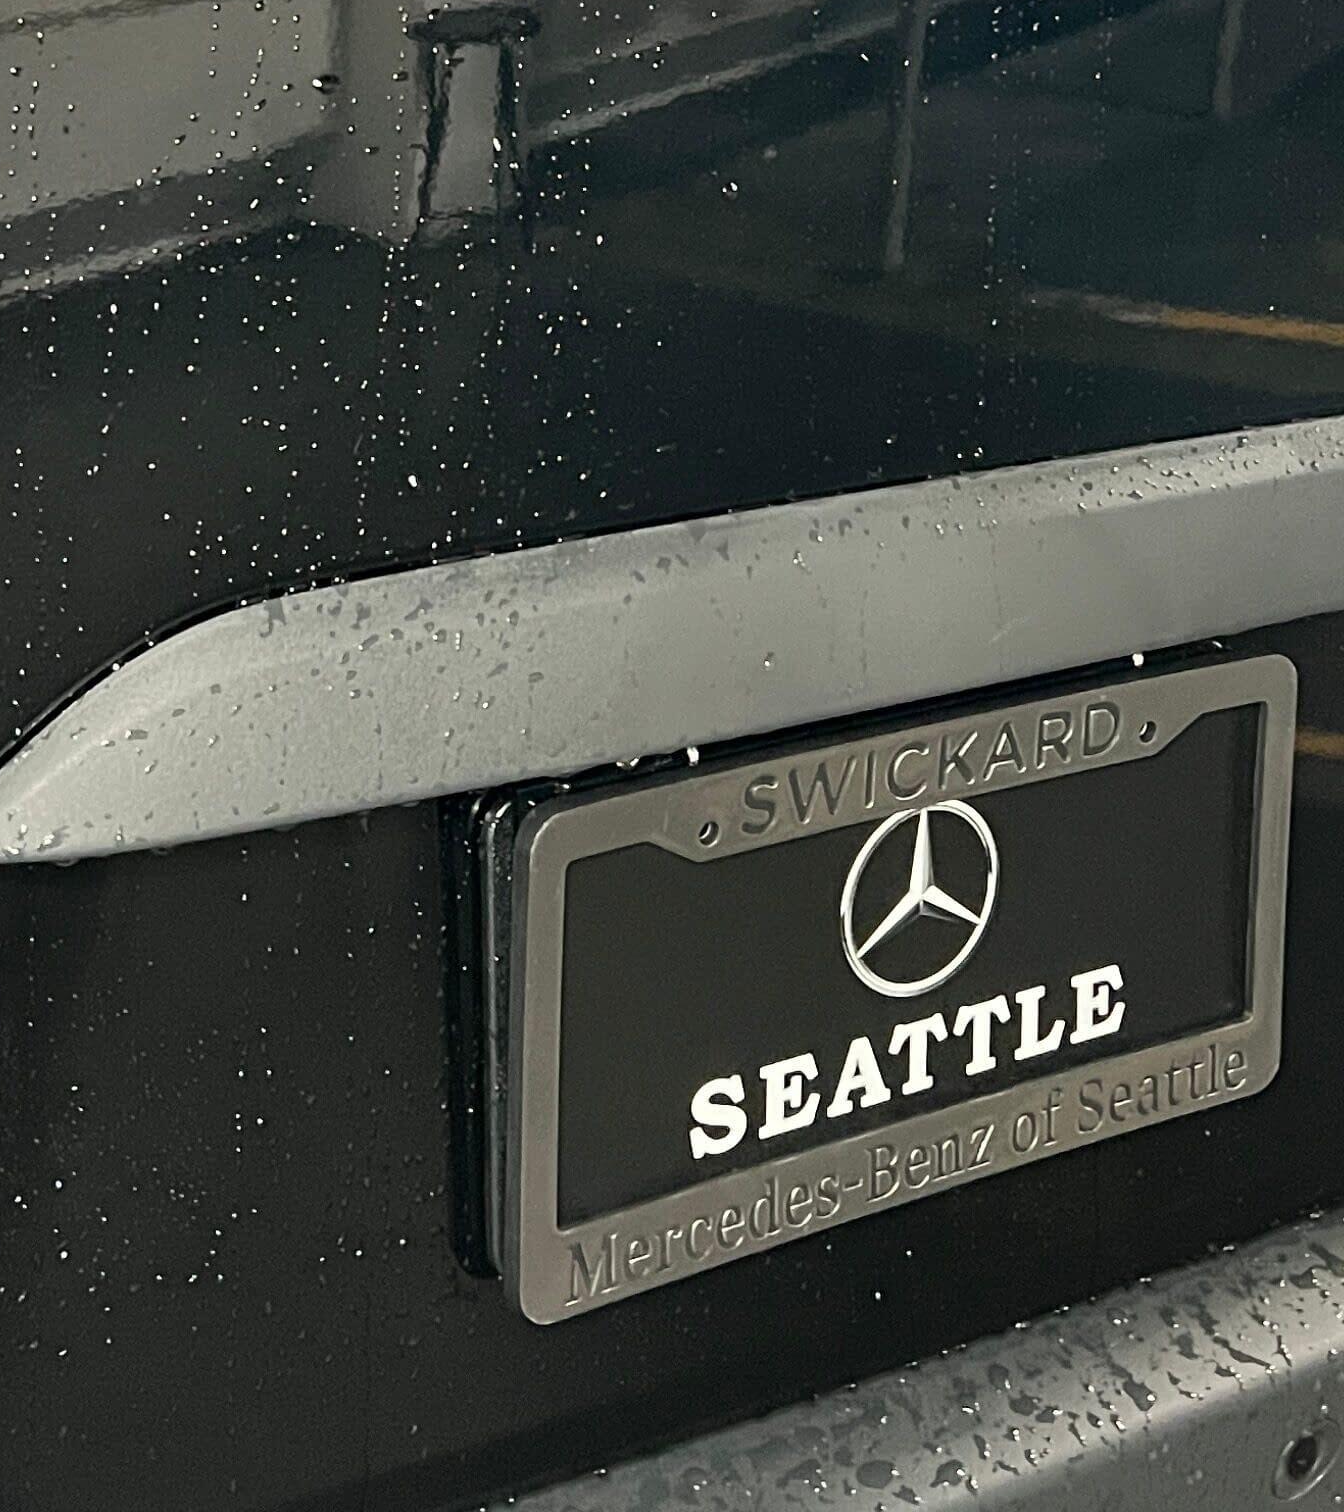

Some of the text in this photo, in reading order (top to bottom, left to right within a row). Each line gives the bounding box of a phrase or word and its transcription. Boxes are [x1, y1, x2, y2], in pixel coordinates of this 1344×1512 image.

[741, 700, 1121, 834] SWICKARD
[688, 963, 1127, 1160] SEATTLE
[565, 1044, 1248, 1307] Mercedes-Benz of Seattle
